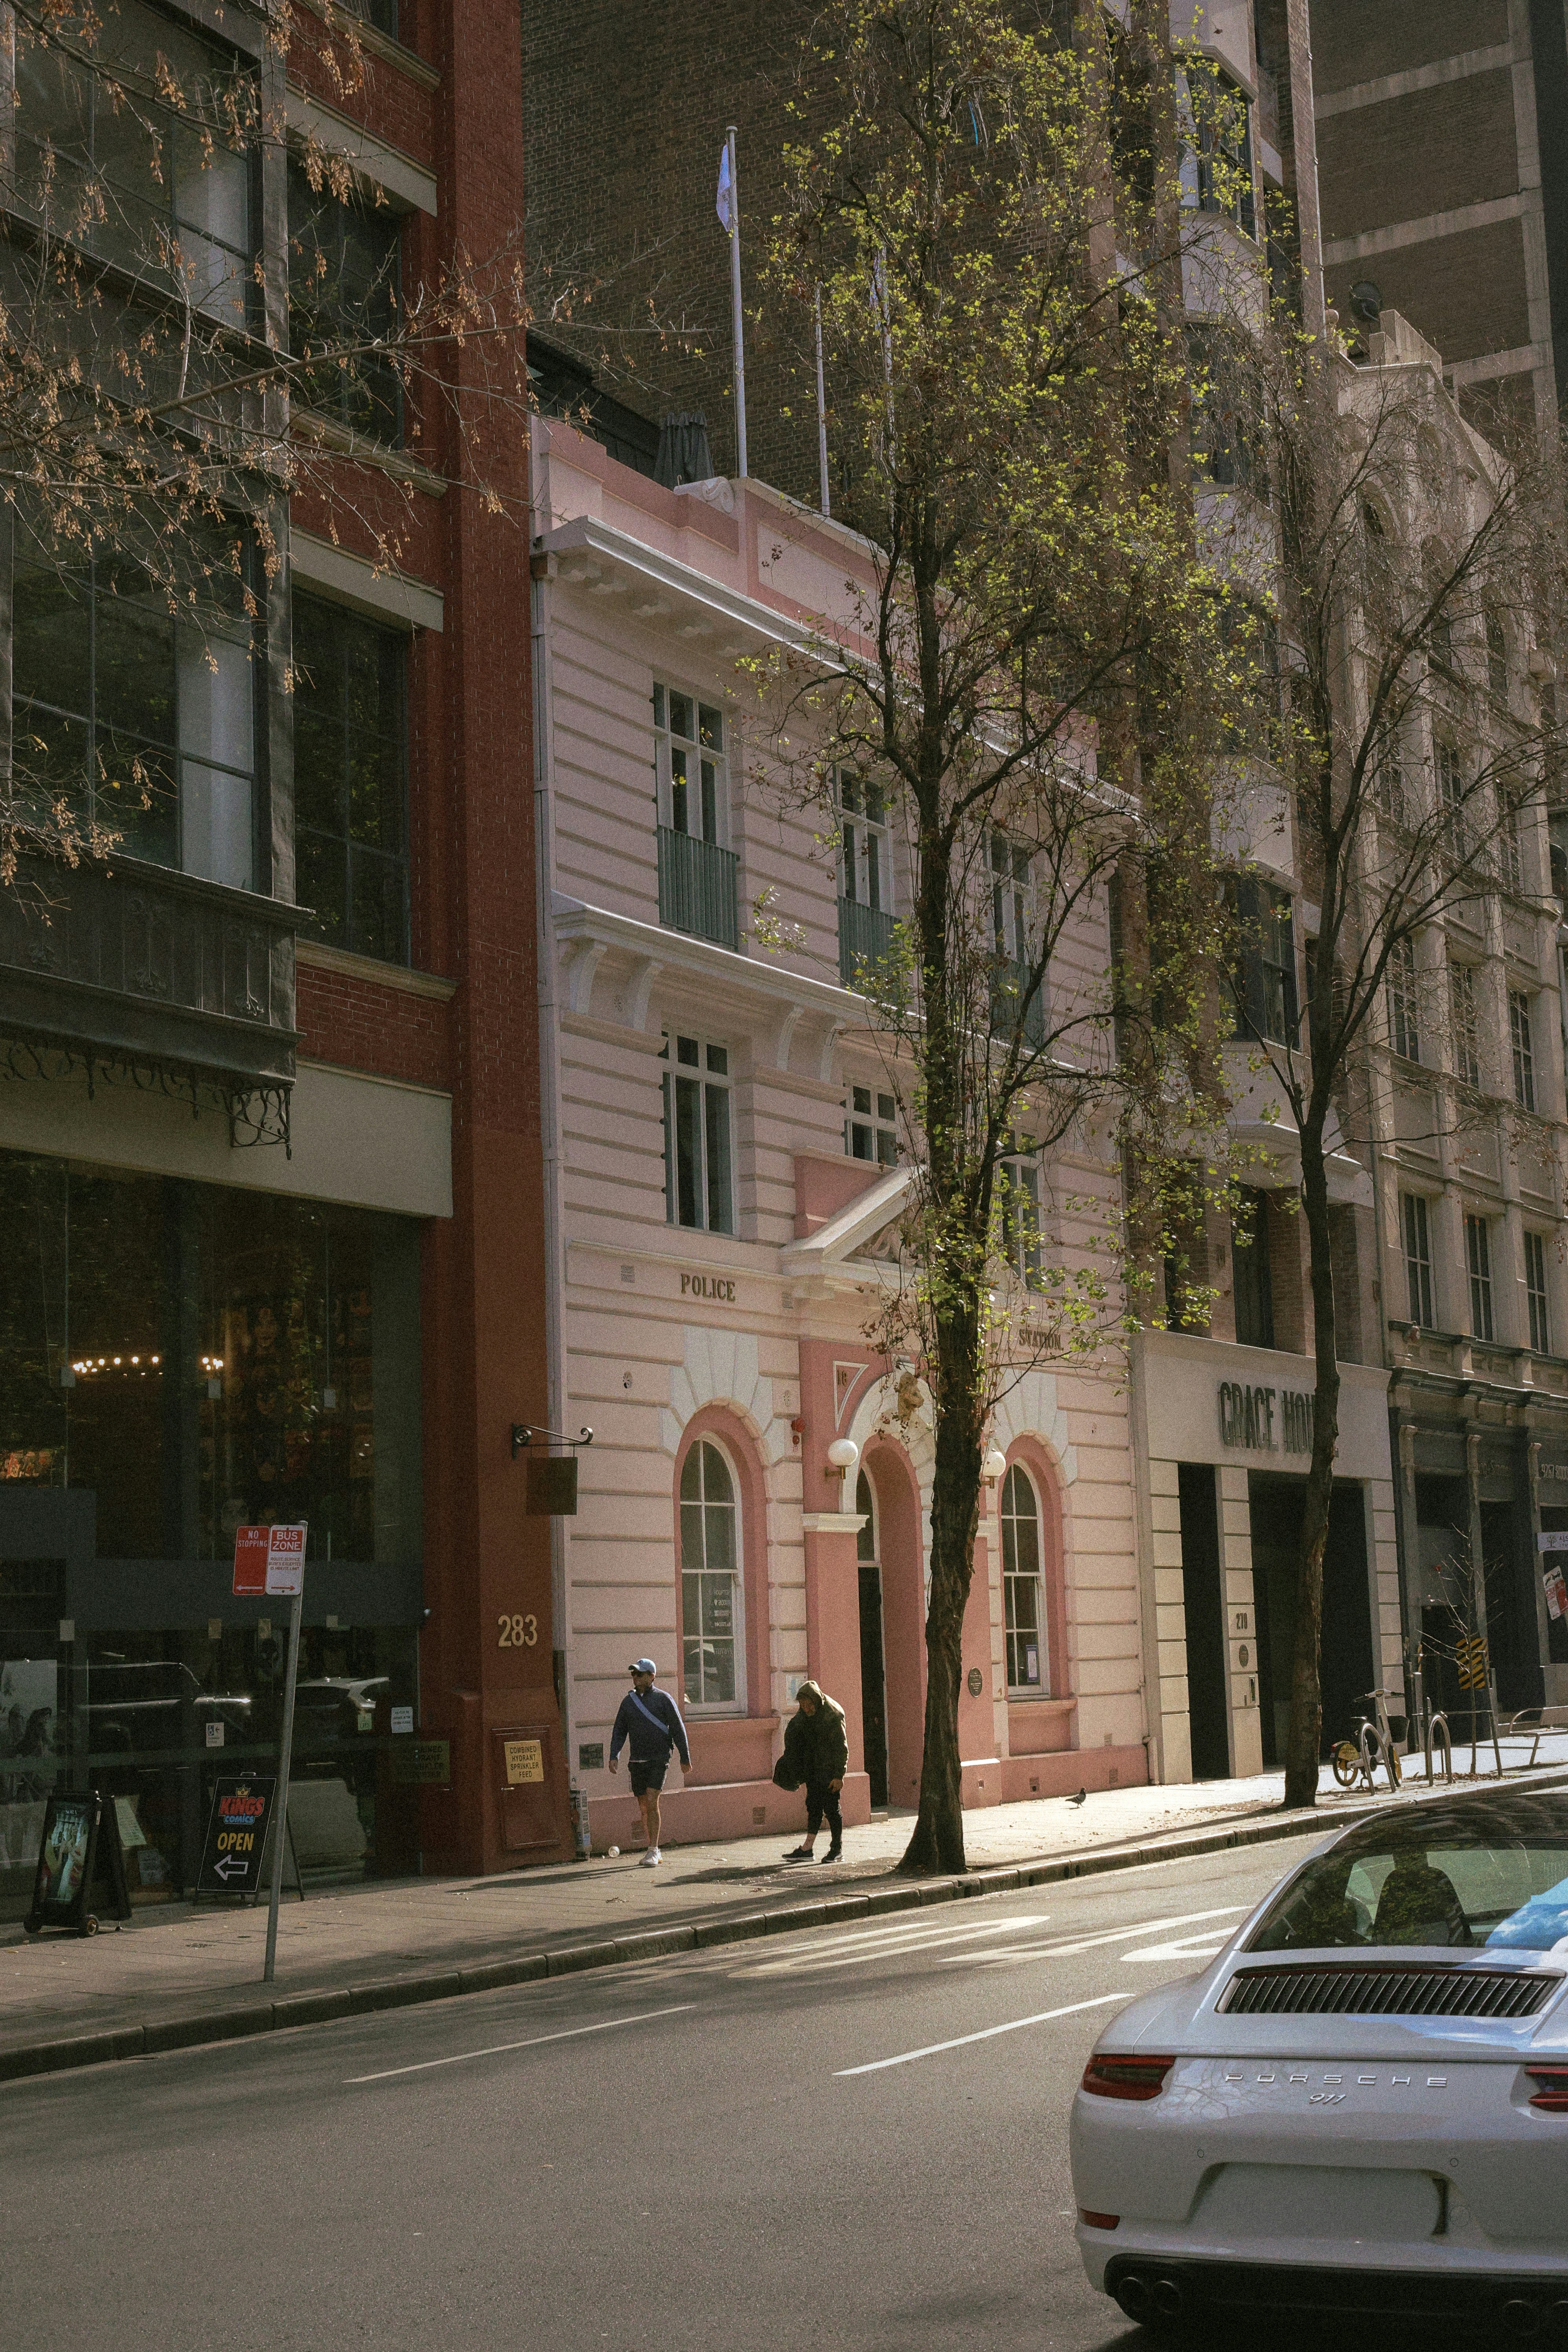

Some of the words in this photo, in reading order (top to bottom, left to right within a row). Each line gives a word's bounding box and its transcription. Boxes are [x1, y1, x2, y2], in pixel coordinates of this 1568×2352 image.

[681, 1273, 735, 1302] POLICE
[1019, 1328, 1061, 1350] STATION
[1220, 1382, 1280, 1451] GRACE
[248, 1530, 259, 1539] NO
[277, 1531, 298, 1541] BUS
[273, 1541, 301, 1550] ZONE
[498, 1614, 537, 1647] 283
[510, 1762, 539, 1771] SPRINKLER
[218, 1832, 254, 1851] OPEN
[1225, 2073, 1447, 2087] PORSCHE
[1309, 2093, 1347, 2105] 911
